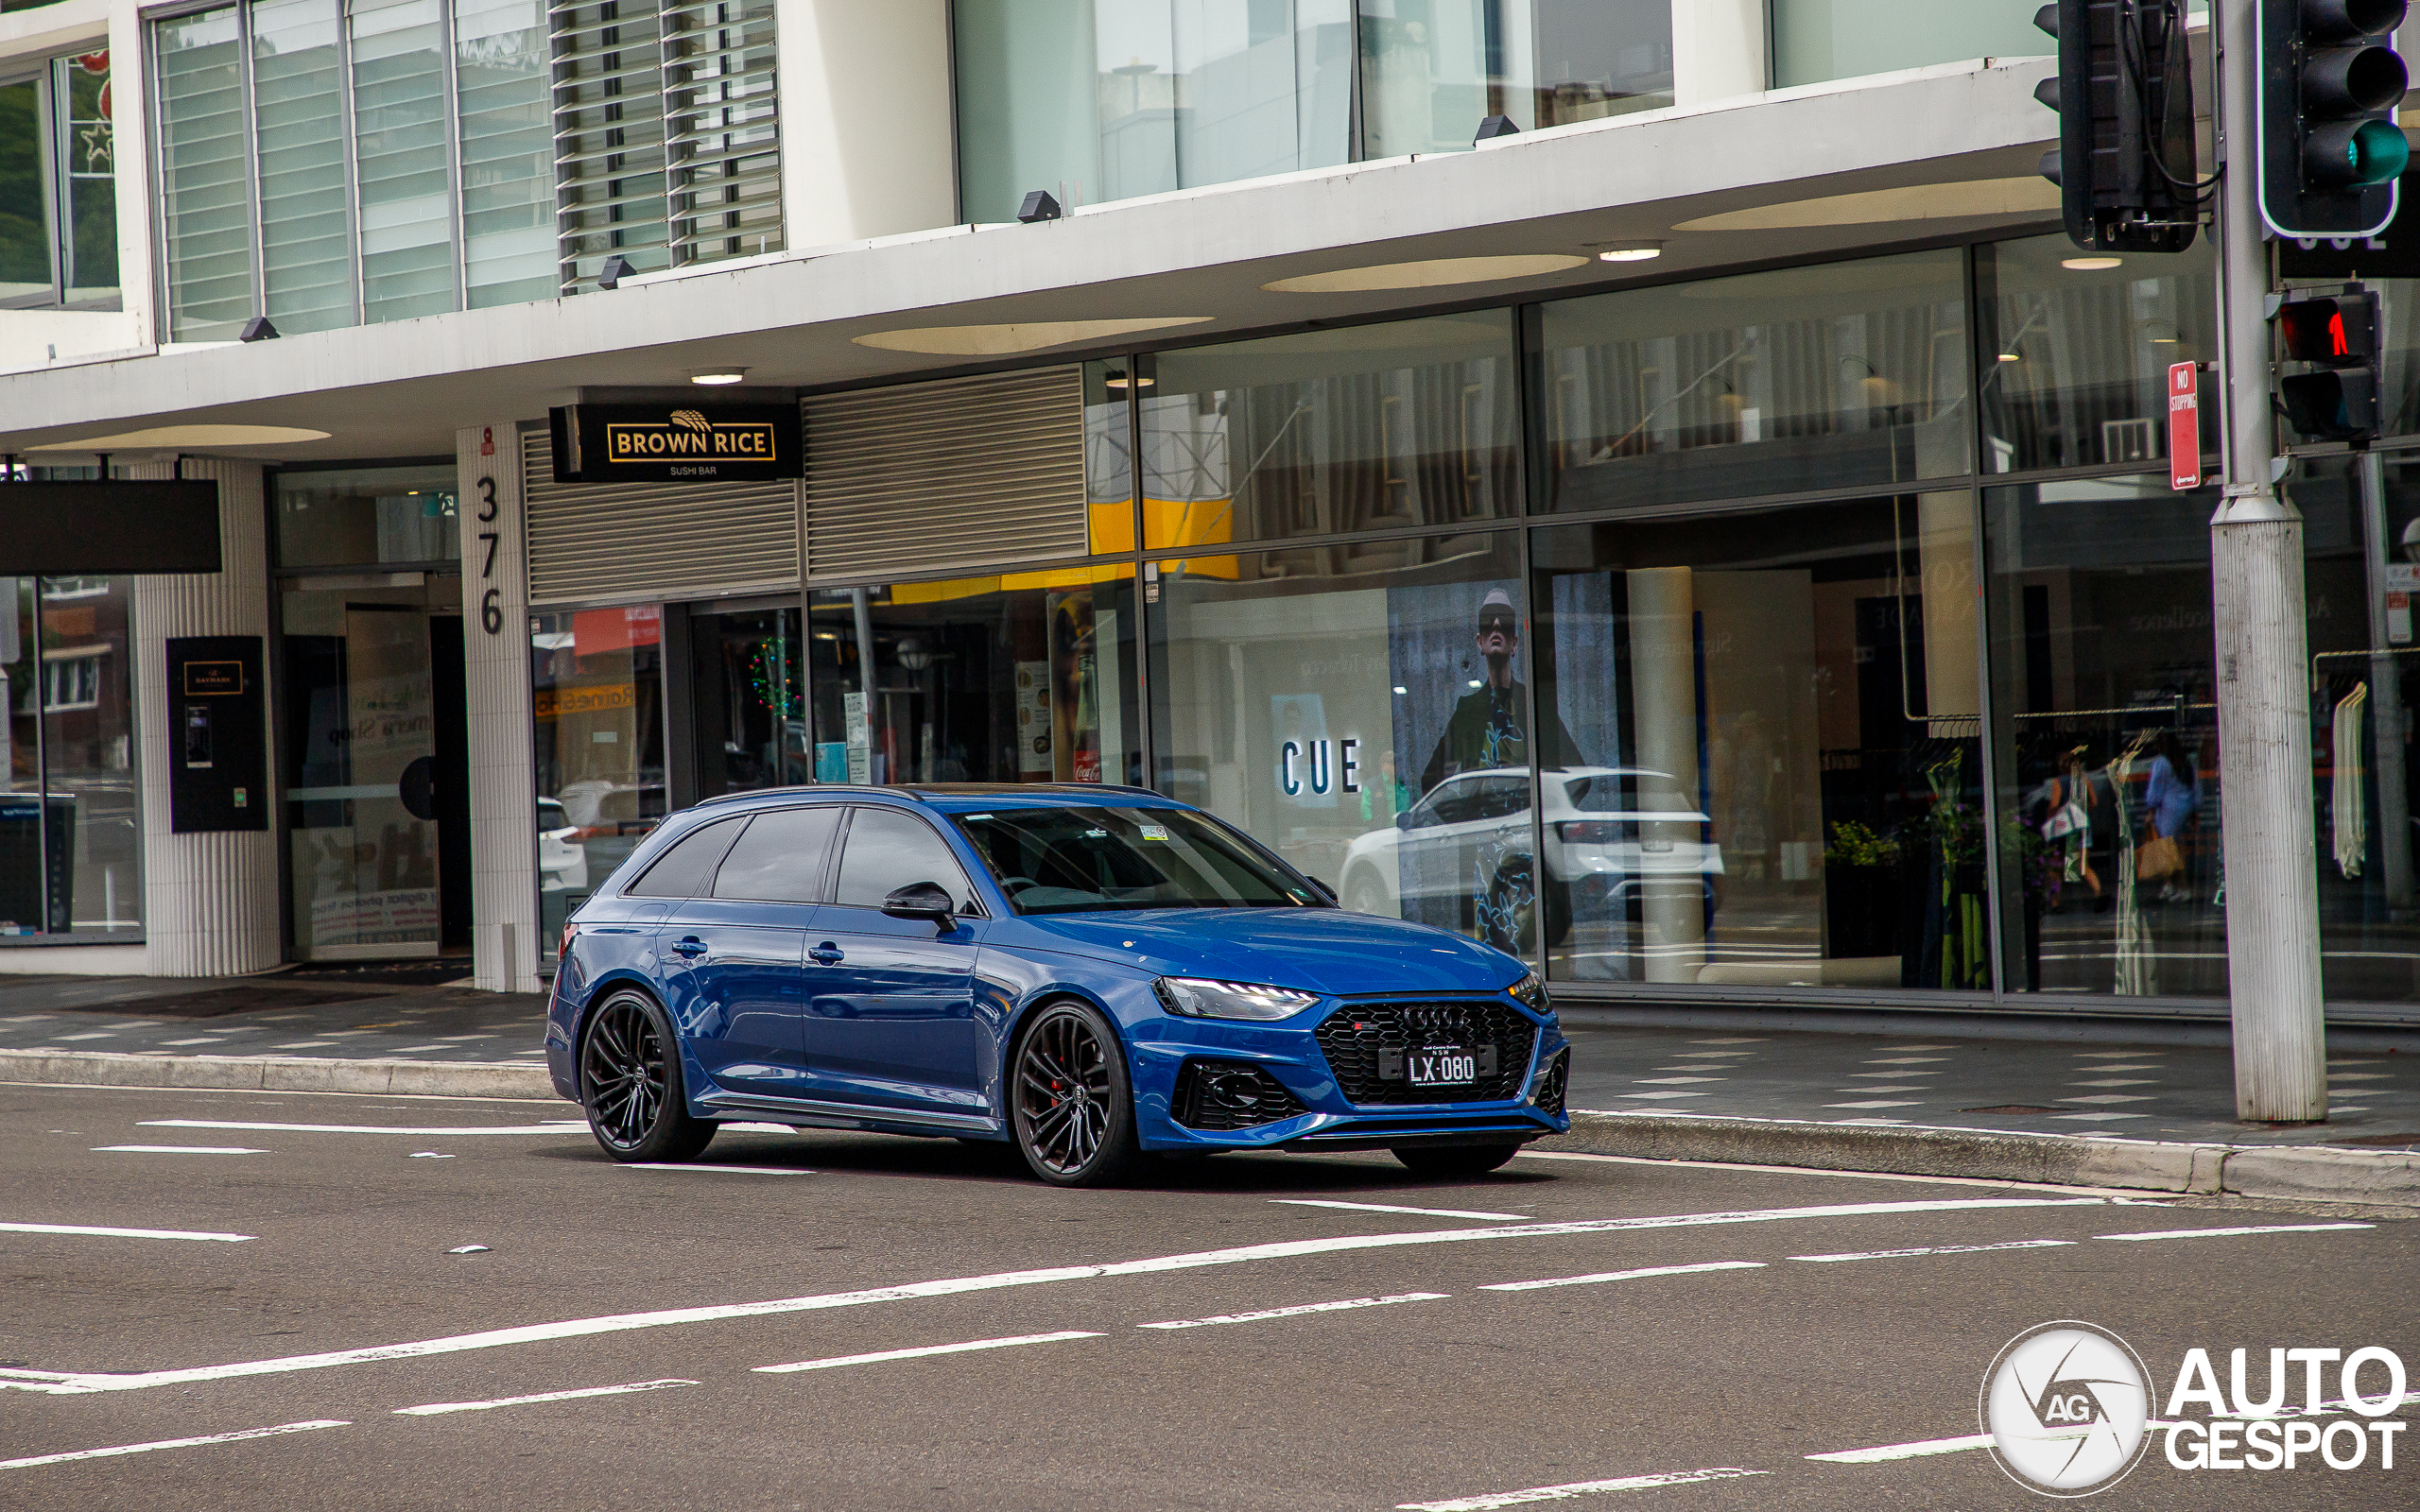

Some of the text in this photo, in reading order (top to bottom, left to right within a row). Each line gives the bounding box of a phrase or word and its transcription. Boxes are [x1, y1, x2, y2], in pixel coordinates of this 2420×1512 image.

[2177, 369, 2188, 389] NO
[2170, 393, 2197, 412] STOPPING
[617, 432, 767, 454] BROWN RICE
[670, 466, 717, 475] SUSHI BAR
[476, 476, 503, 636] 376
[1282, 738, 1362, 797] CUE
